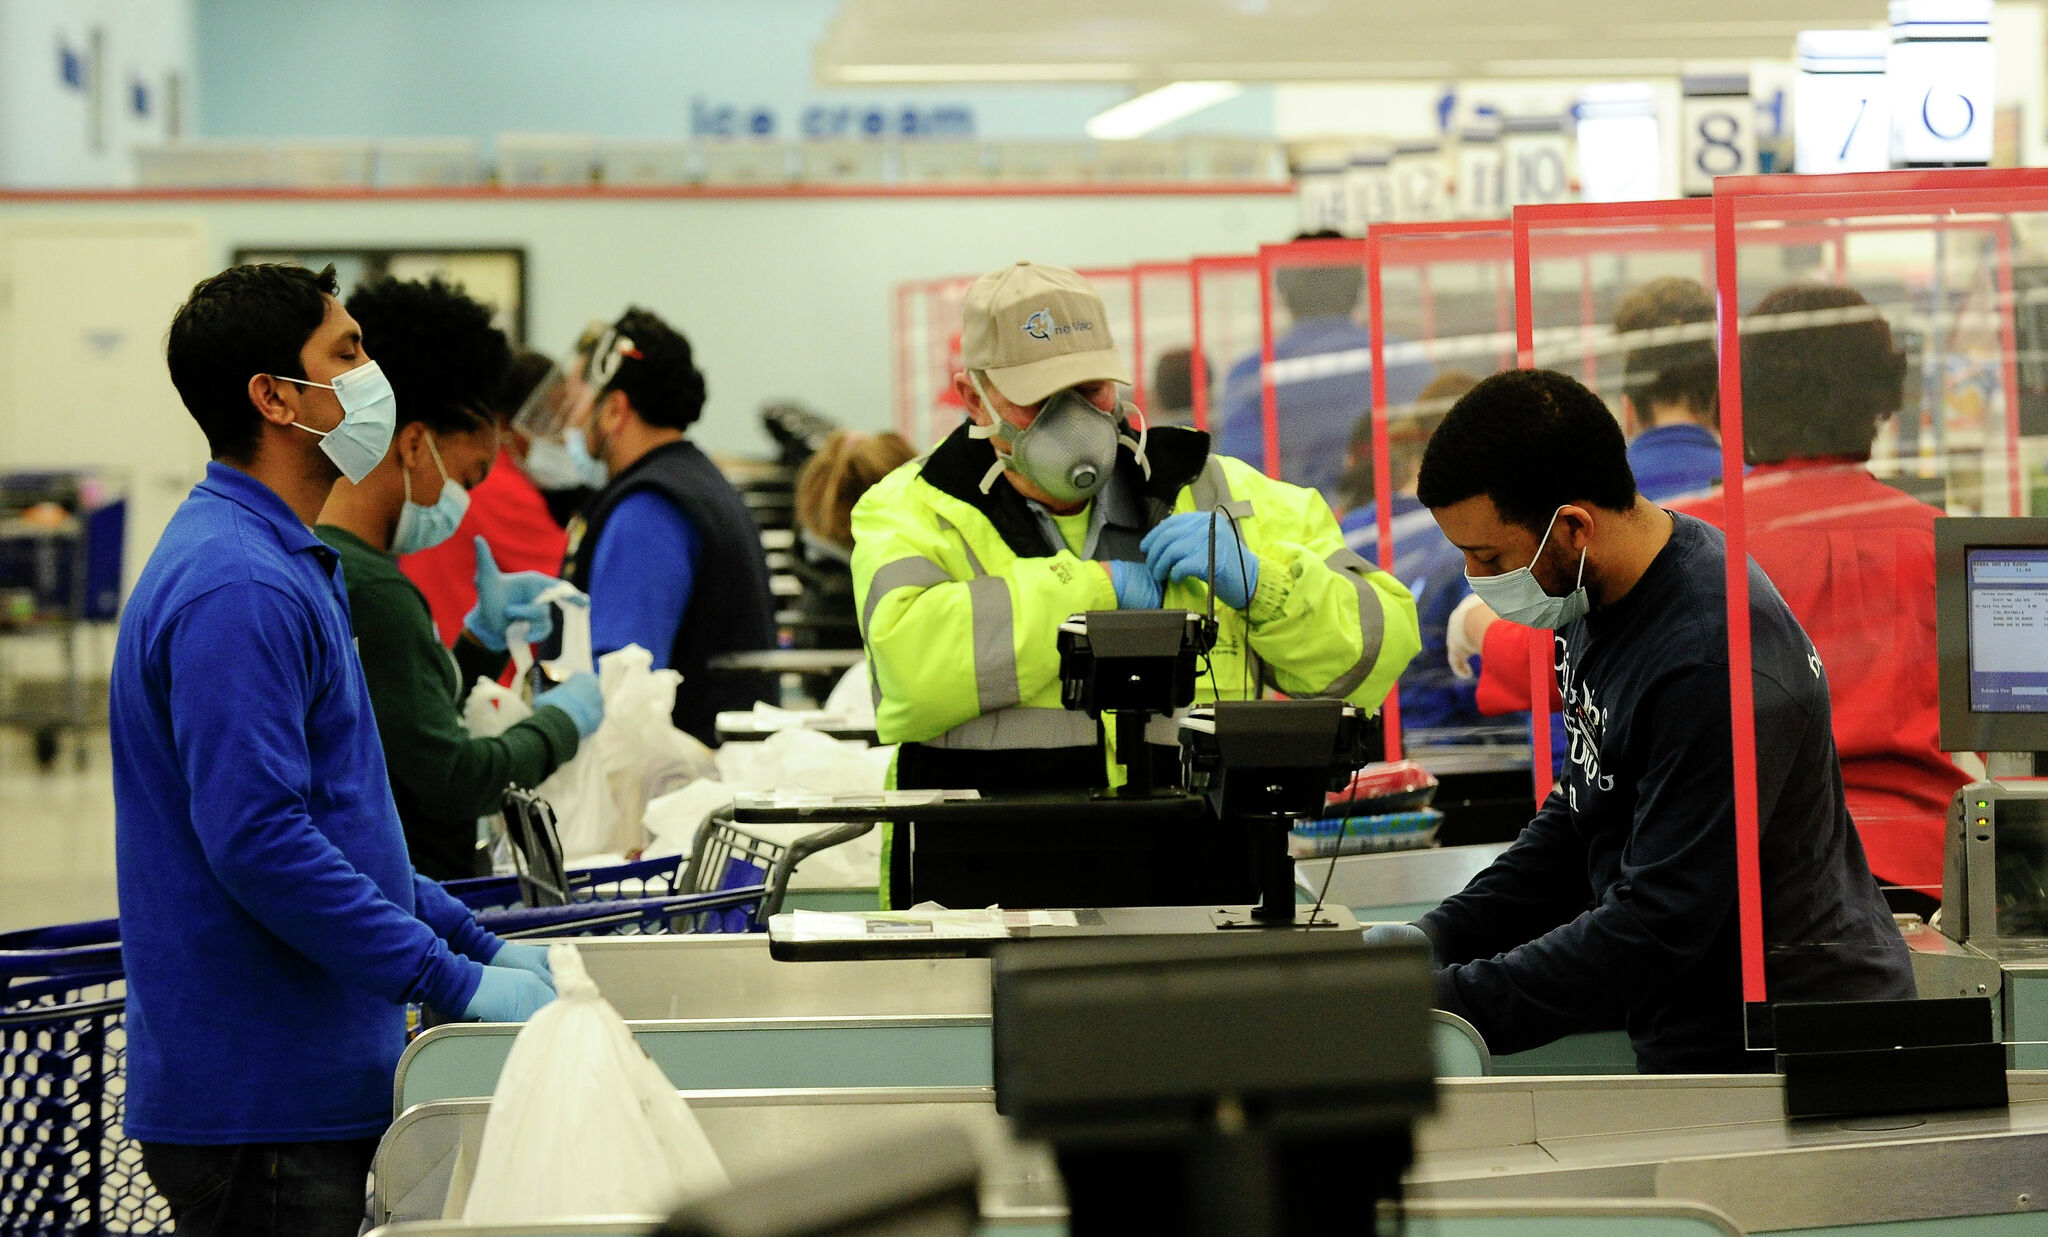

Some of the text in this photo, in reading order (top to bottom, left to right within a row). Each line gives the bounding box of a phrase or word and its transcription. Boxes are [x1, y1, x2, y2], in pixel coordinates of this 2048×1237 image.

[690, 92, 976, 137] ice cream
[1695, 110, 1743, 177] 8
[1473, 163, 1507, 205] 11
[1517, 148, 1566, 199] 10
